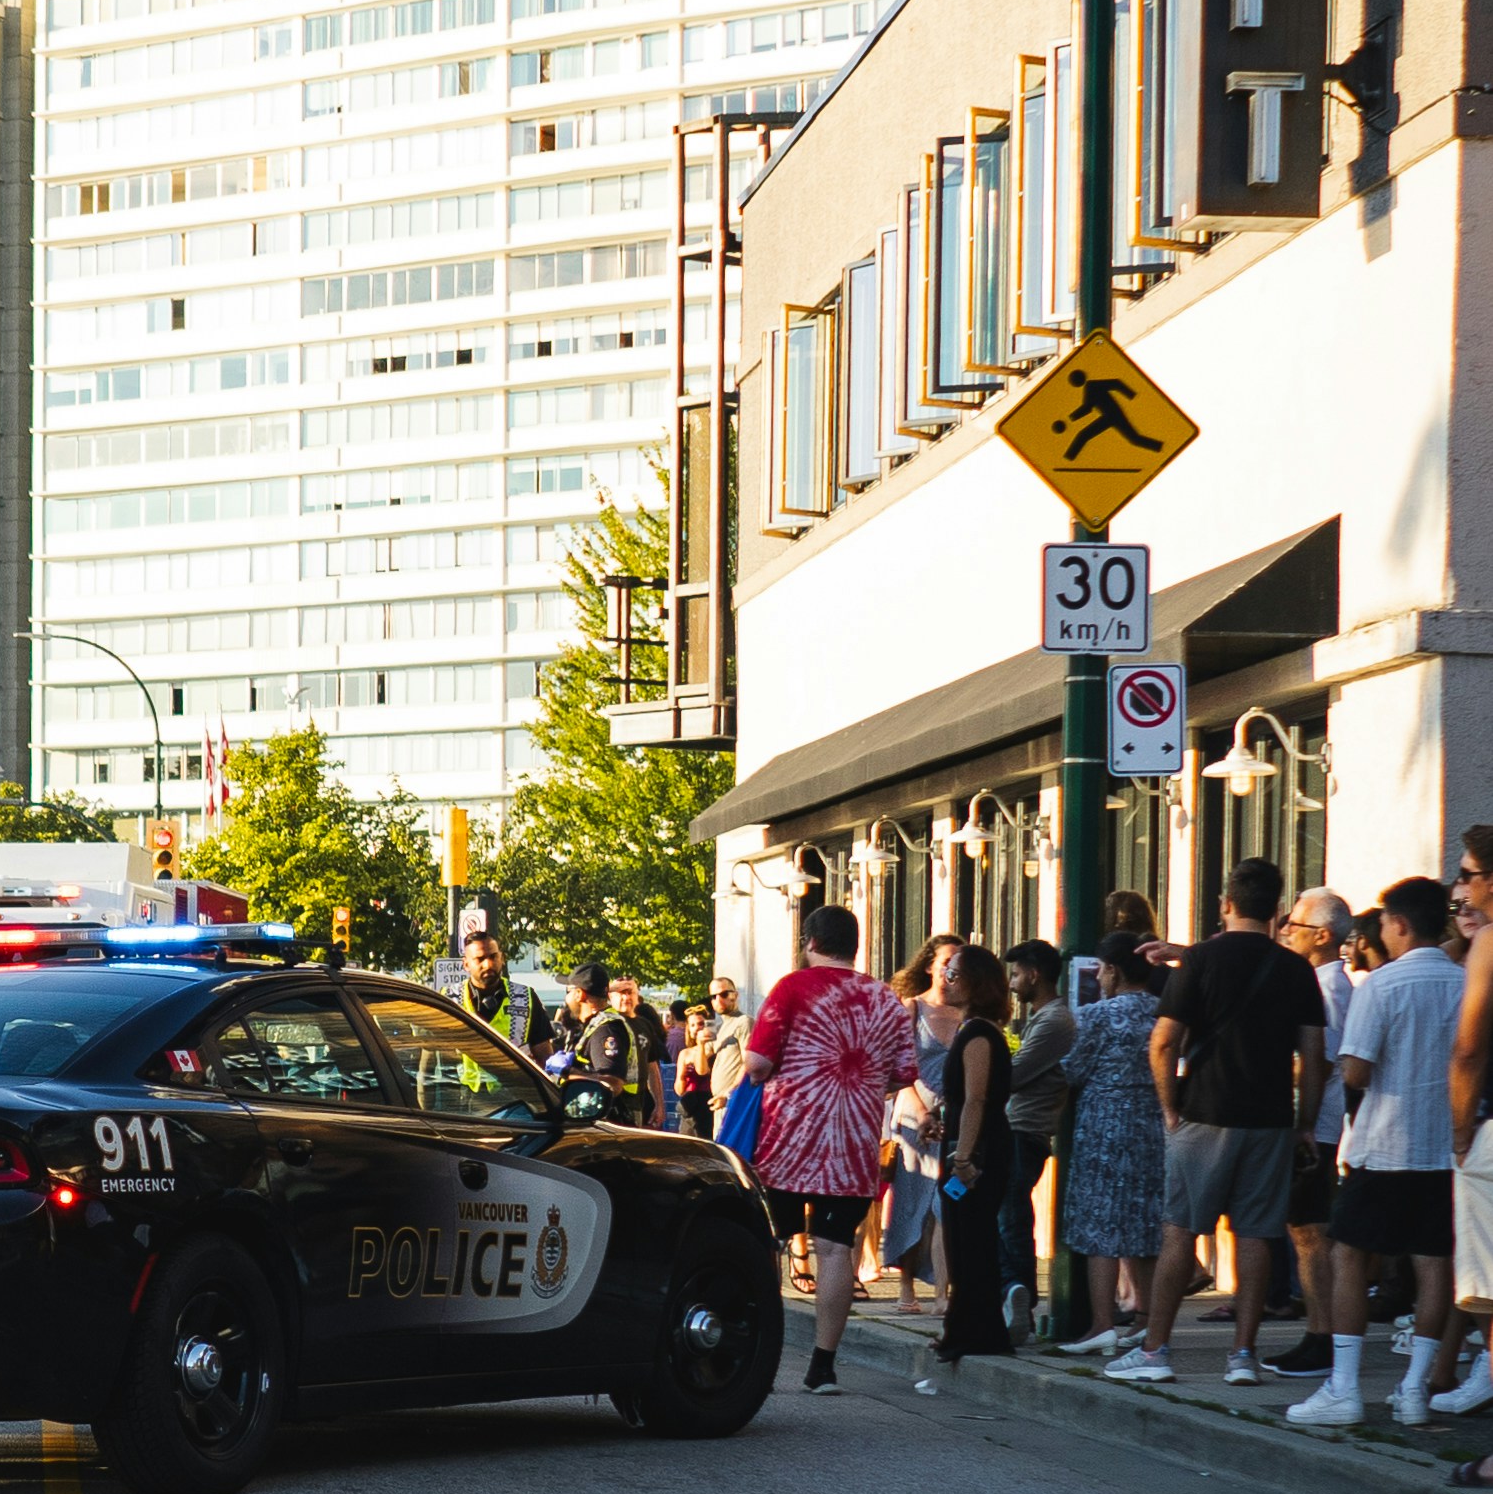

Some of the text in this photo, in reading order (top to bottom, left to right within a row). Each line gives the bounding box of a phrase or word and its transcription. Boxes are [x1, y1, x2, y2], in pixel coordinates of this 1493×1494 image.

[1056, 555, 1135, 610] 30
[1059, 617, 1131, 642] km/h
[438, 963, 465, 973] SIGNA
[94, 1115, 174, 1172] 911
[101, 1178, 175, 1193] EMERGENCY
[458, 1201, 528, 1223] VANCOUVER
[348, 1226, 528, 1299] POLICE
